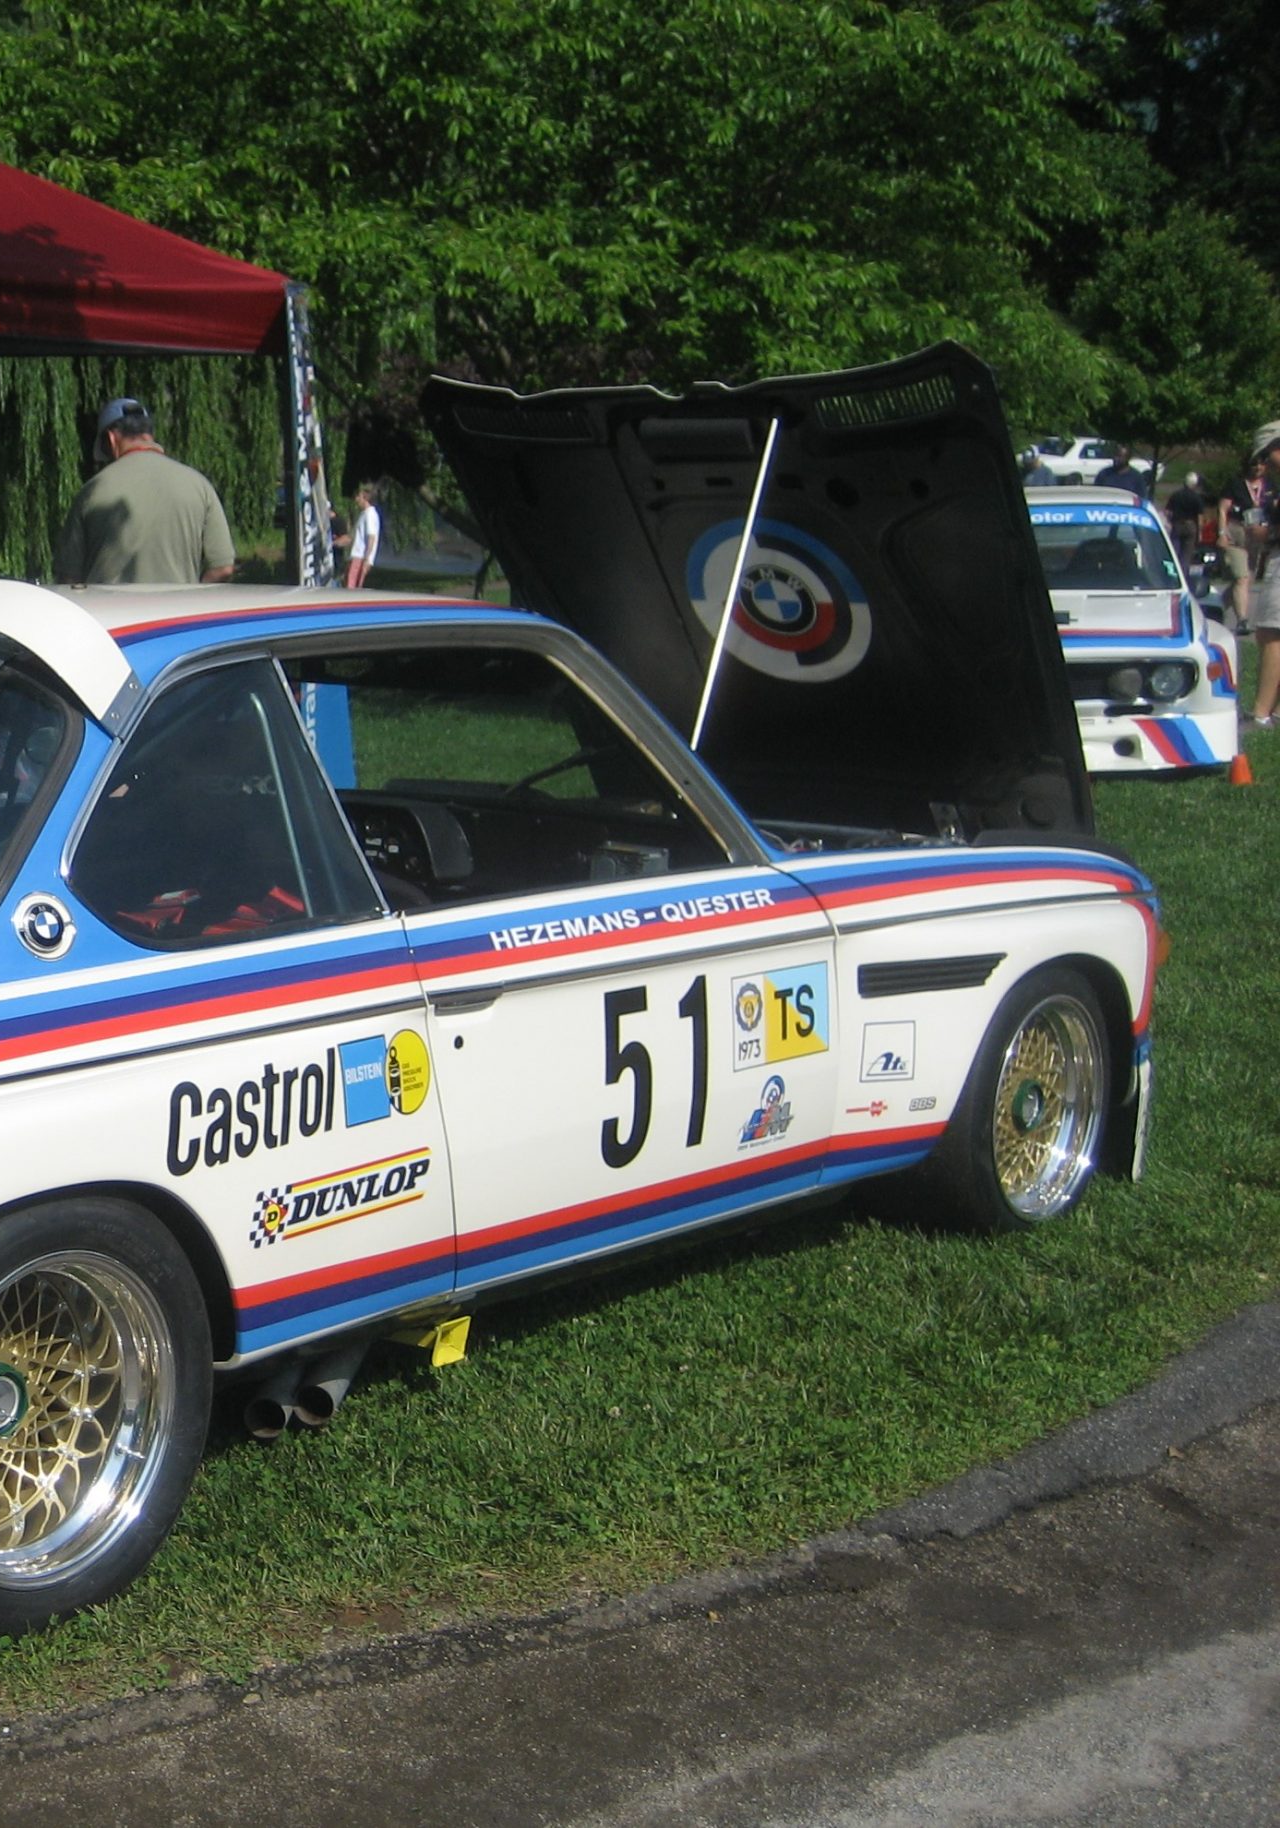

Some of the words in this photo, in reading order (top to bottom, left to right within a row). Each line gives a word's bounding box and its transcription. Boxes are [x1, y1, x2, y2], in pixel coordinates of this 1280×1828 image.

[1029, 511, 1074, 524] otor
[1085, 510, 1154, 527] Works
[489, 909, 641, 950] HEZEMANS
[661, 888, 775, 923] QUESTER
[775, 984, 815, 1041] TS
[738, 1039, 762, 1062] 1973
[344, 1062, 383, 1085] BILSTEIN
[601, 974, 708, 1169] 51
[166, 1047, 336, 1177] Castrol
[908, 1096, 937, 1111] BBS
[286, 1158, 430, 1226] DUNLOP
[265, 1210, 279, 1224] D
